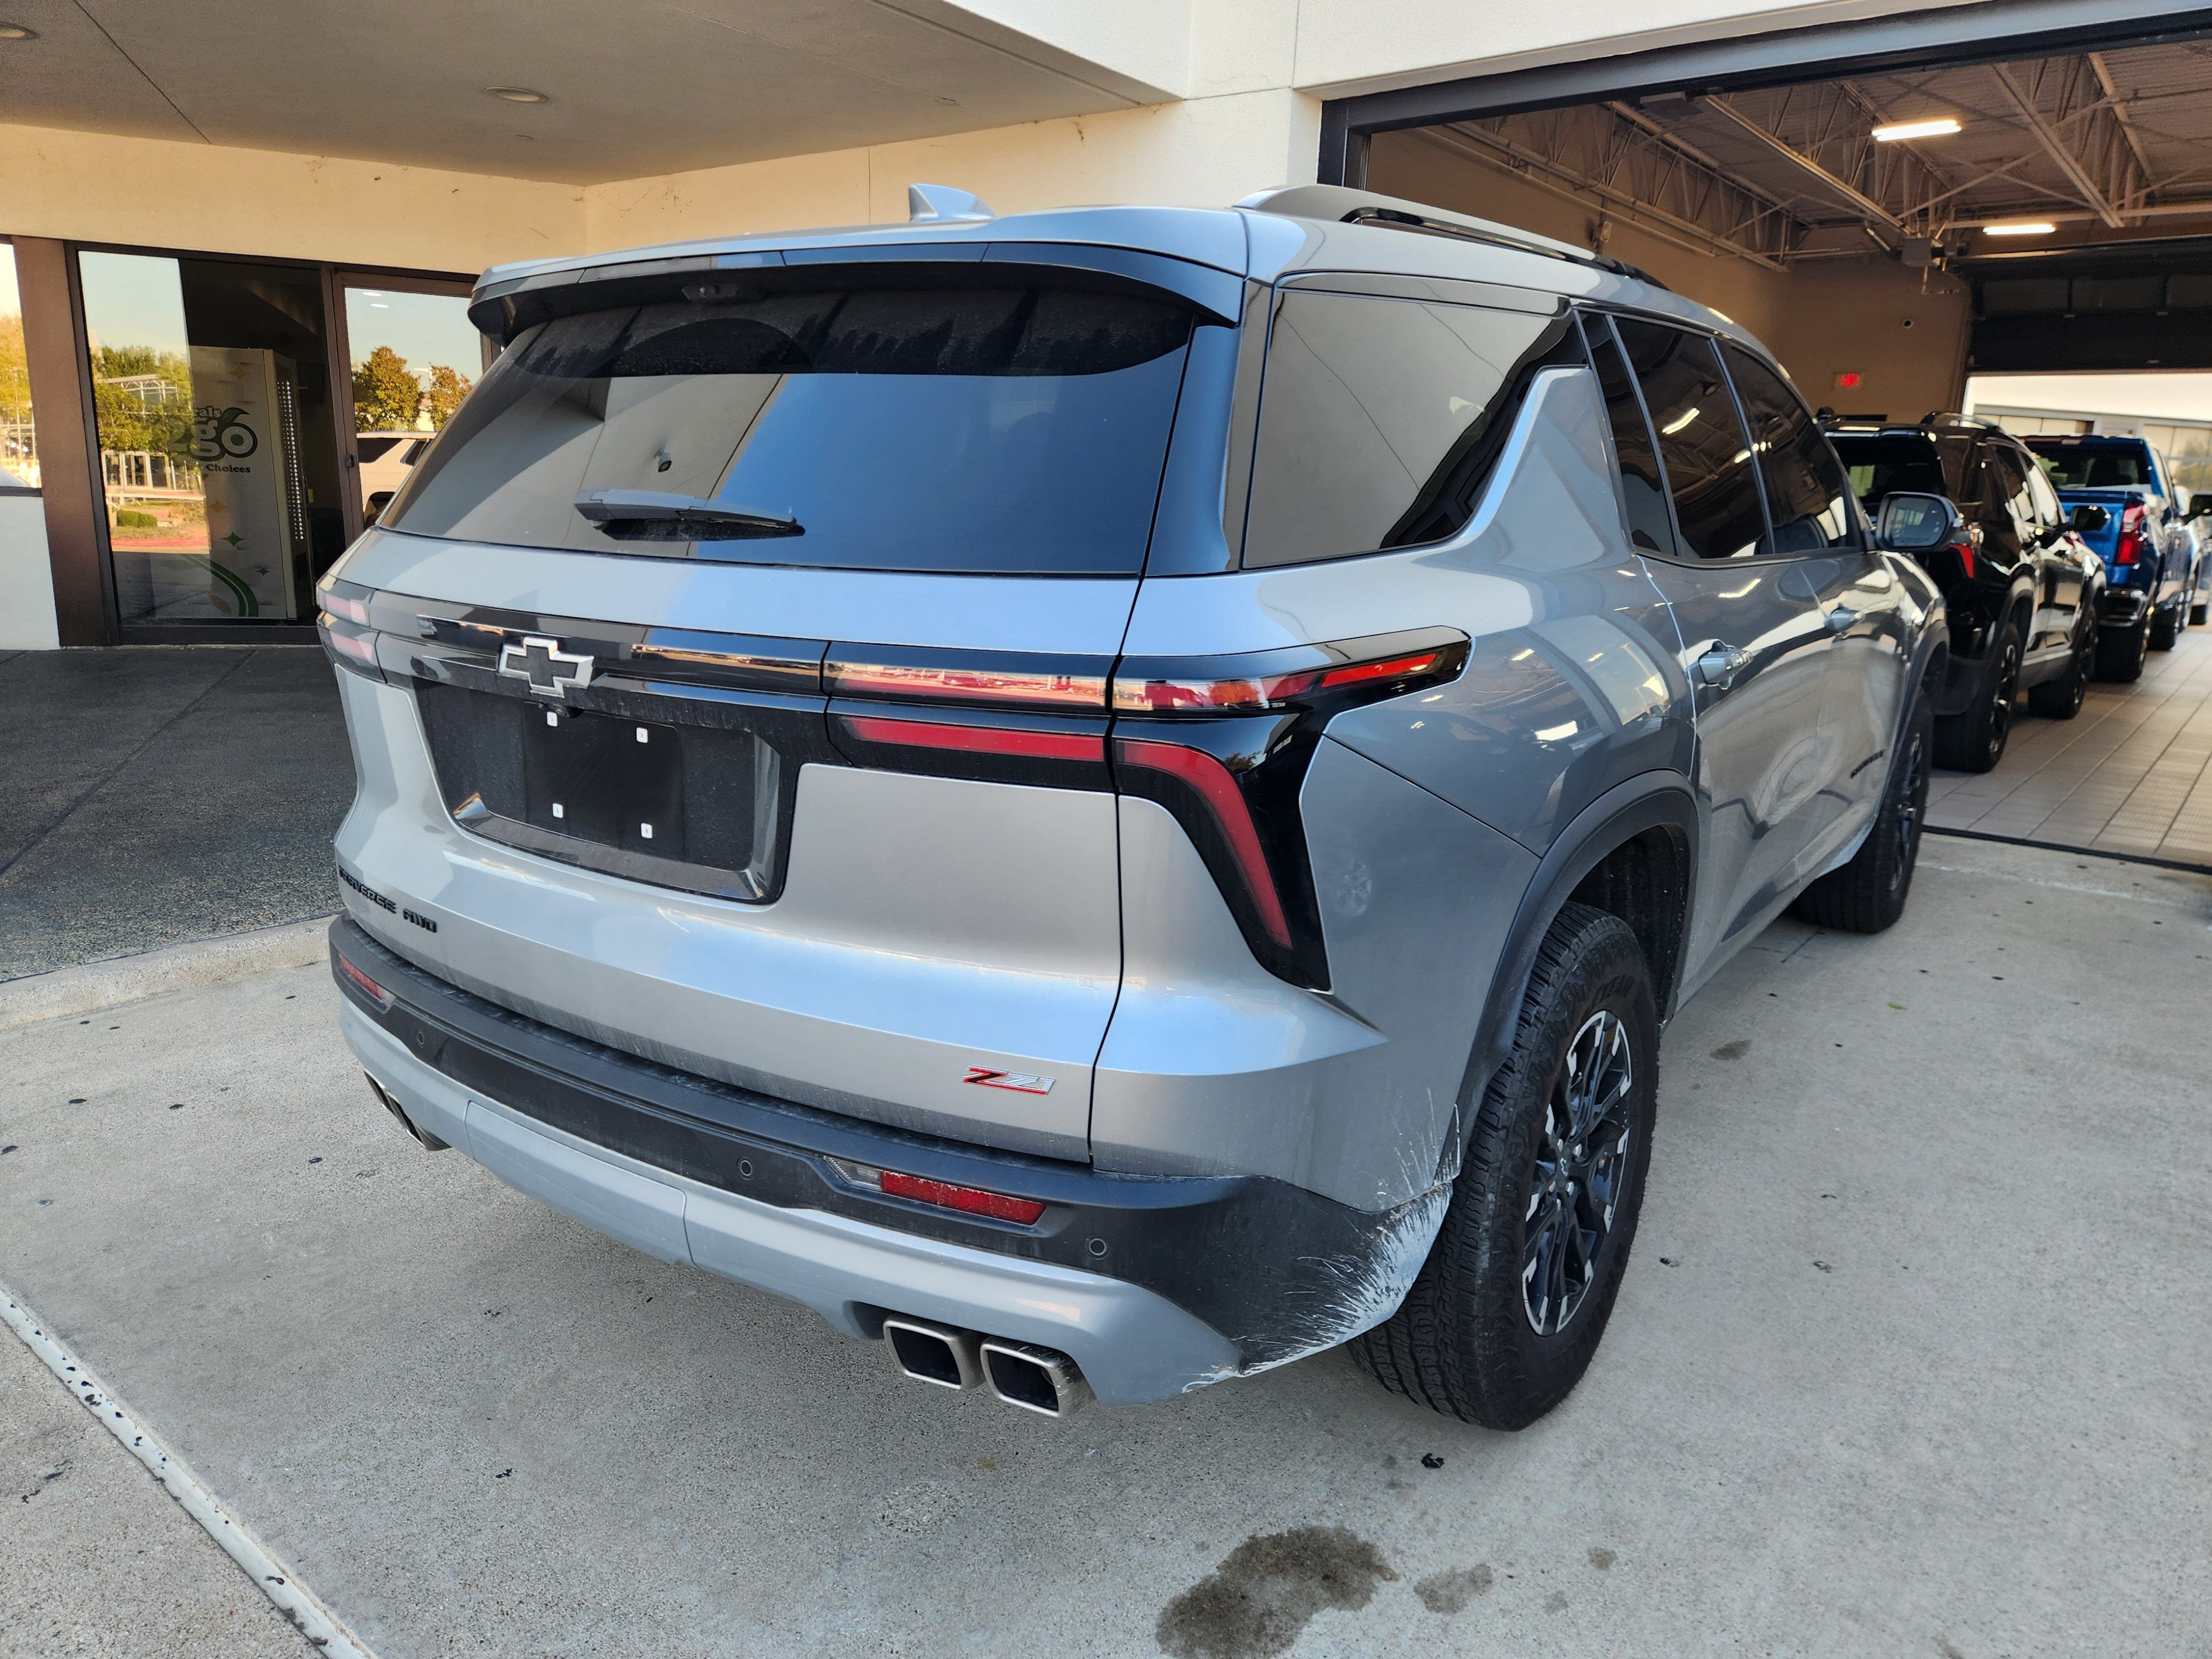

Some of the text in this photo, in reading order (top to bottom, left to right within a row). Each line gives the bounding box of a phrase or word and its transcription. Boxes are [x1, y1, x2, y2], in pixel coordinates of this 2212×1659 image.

[205, 464, 251, 473] Choices
[402, 908, 437, 933] AWD
[962, 1065, 1057, 1095] Z71
